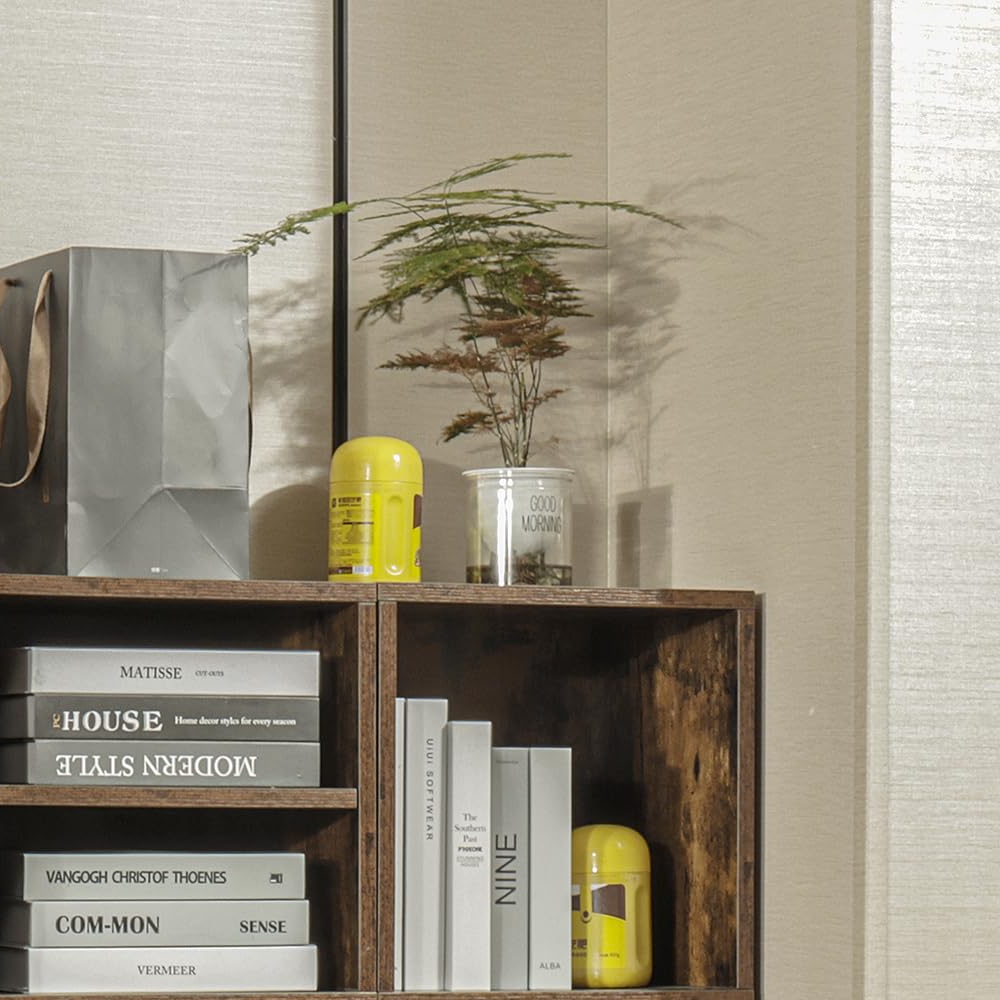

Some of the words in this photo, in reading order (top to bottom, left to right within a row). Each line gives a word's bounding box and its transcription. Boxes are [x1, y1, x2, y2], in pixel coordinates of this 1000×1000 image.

[530, 495, 556, 513] GOOD
[522, 514, 562, 534] MORNING
[120, 666, 182, 679] MATISSE
[61, 710, 163, 732] HOUSE
[175, 715, 198, 725] Home
[199, 715, 219, 725] decor
[220, 716, 240, 727] styles
[241, 715, 252, 725] for
[252, 718, 271, 727] every
[55, 754, 134, 777] STYLE
[143, 755, 257, 778] MODERN
[425, 770, 434, 841] SOFTWEAR
[46, 870, 108, 884] VANGOGH
[112, 870, 169, 884] CHRISTOF
[172, 871, 227, 884] THOENES
[495, 833, 517, 906] NINE
[55, 915, 160, 935] COM-MON
[239, 920, 287, 934] SENSE
[137, 965, 197, 976] VERMEER
